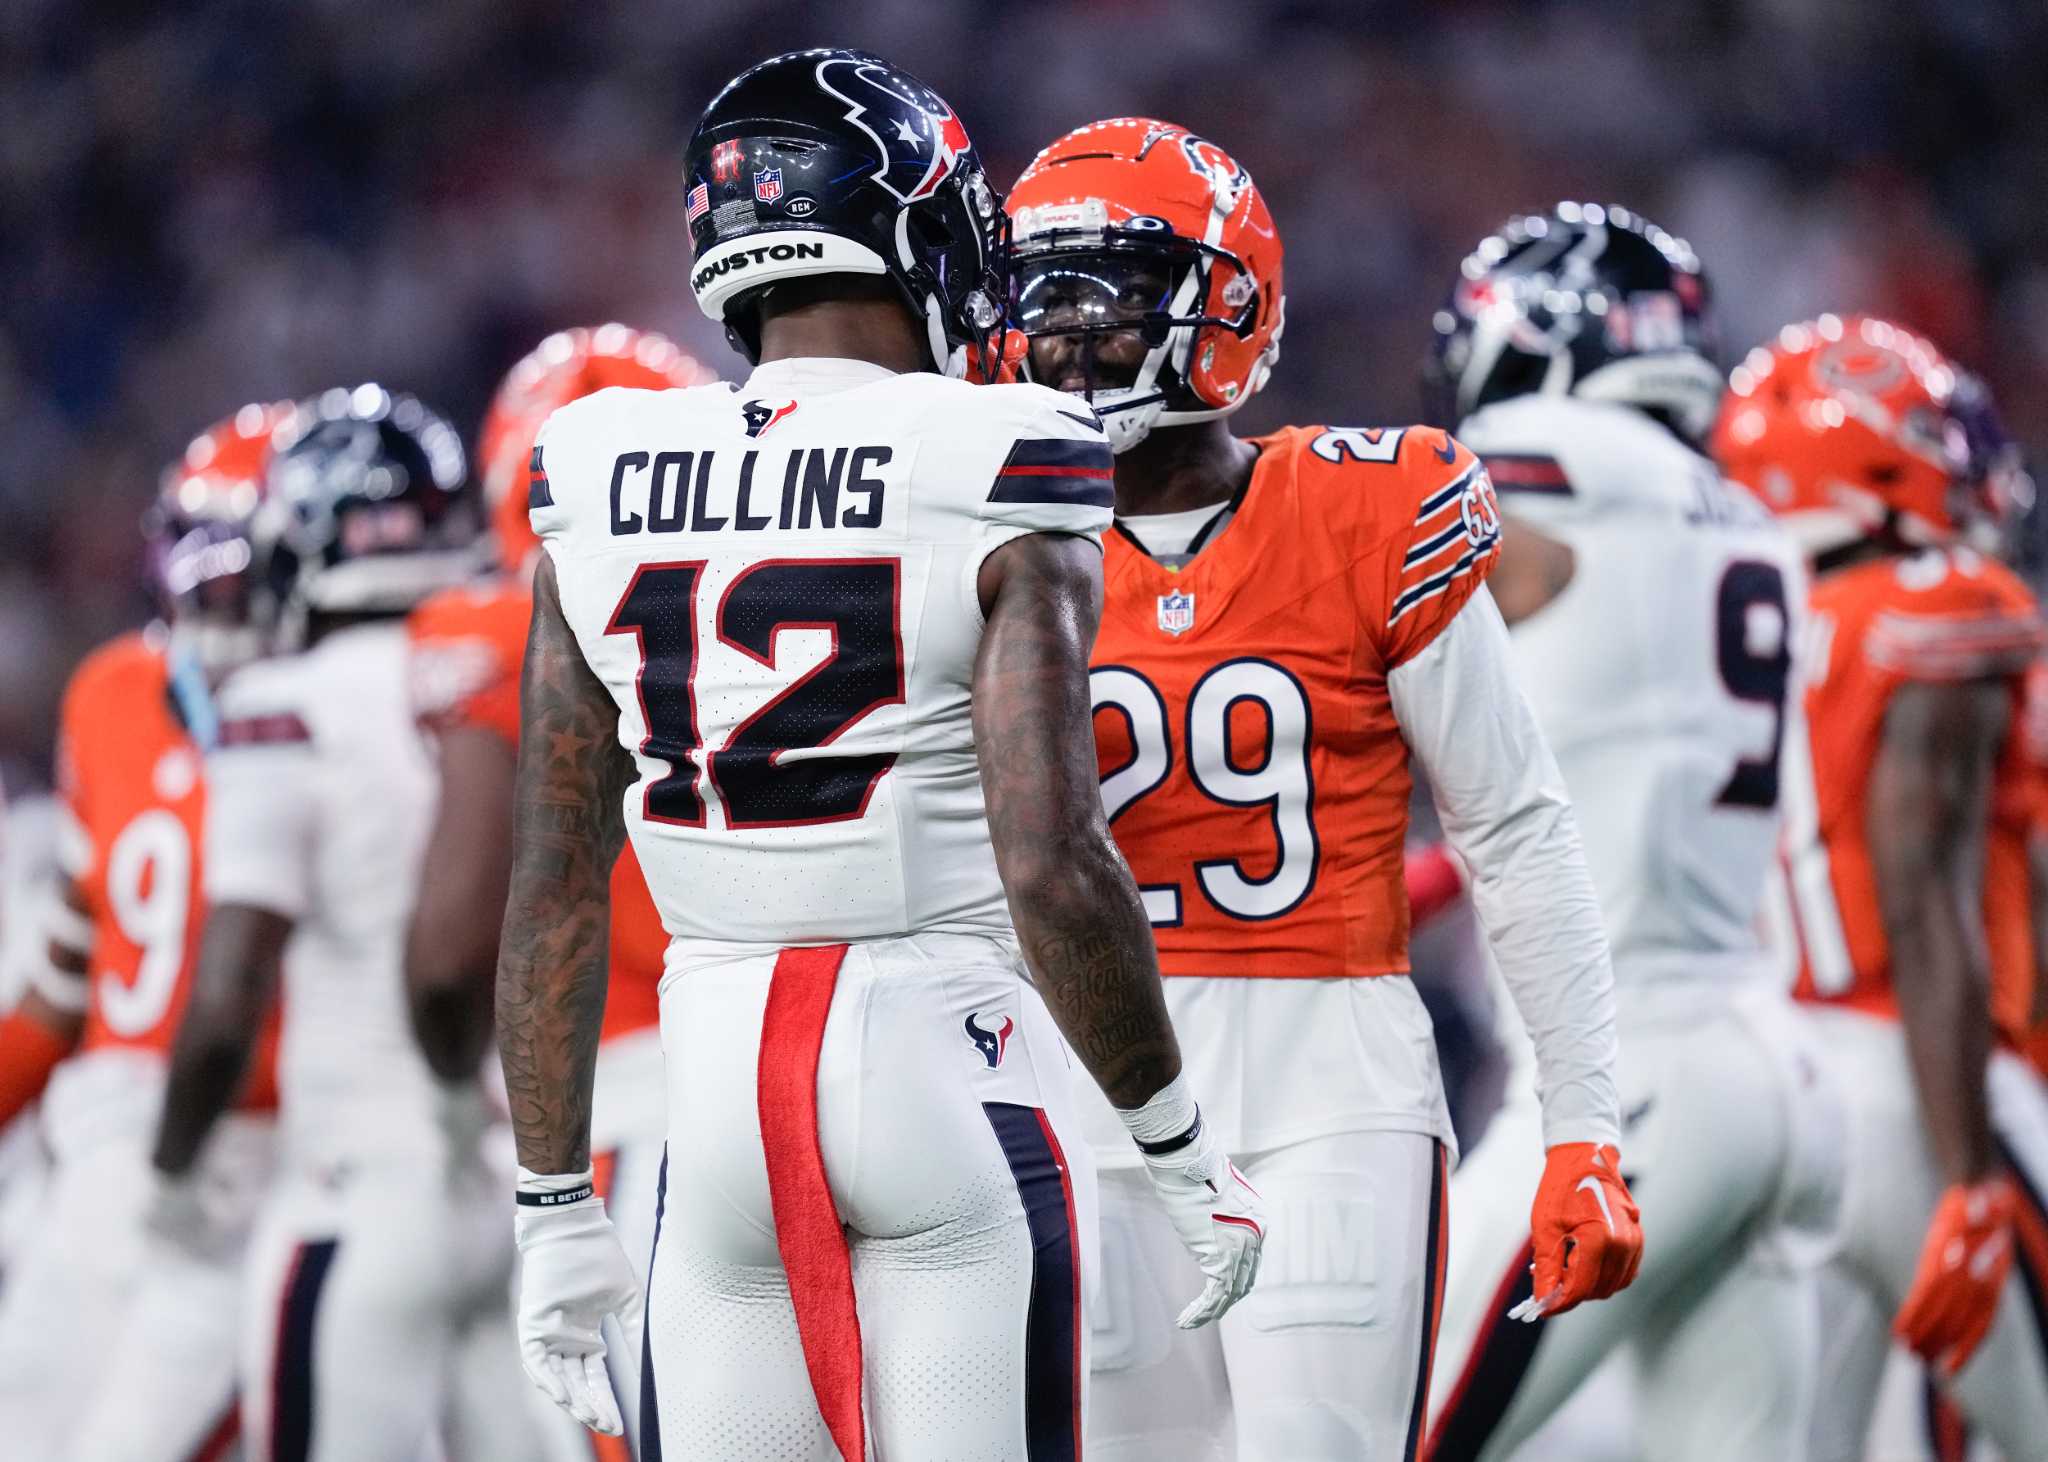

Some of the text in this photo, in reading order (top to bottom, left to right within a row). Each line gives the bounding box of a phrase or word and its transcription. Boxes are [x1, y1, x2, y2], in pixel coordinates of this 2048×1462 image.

[758, 182, 780, 199] NFL
[791, 203, 811, 213] RCM
[692, 243, 823, 294] HOUSTON
[609, 446, 893, 536] COLLINS
[603, 557, 906, 830] 12
[1089, 656, 1321, 928] 29
[540, 1196, 556, 1204] BE
